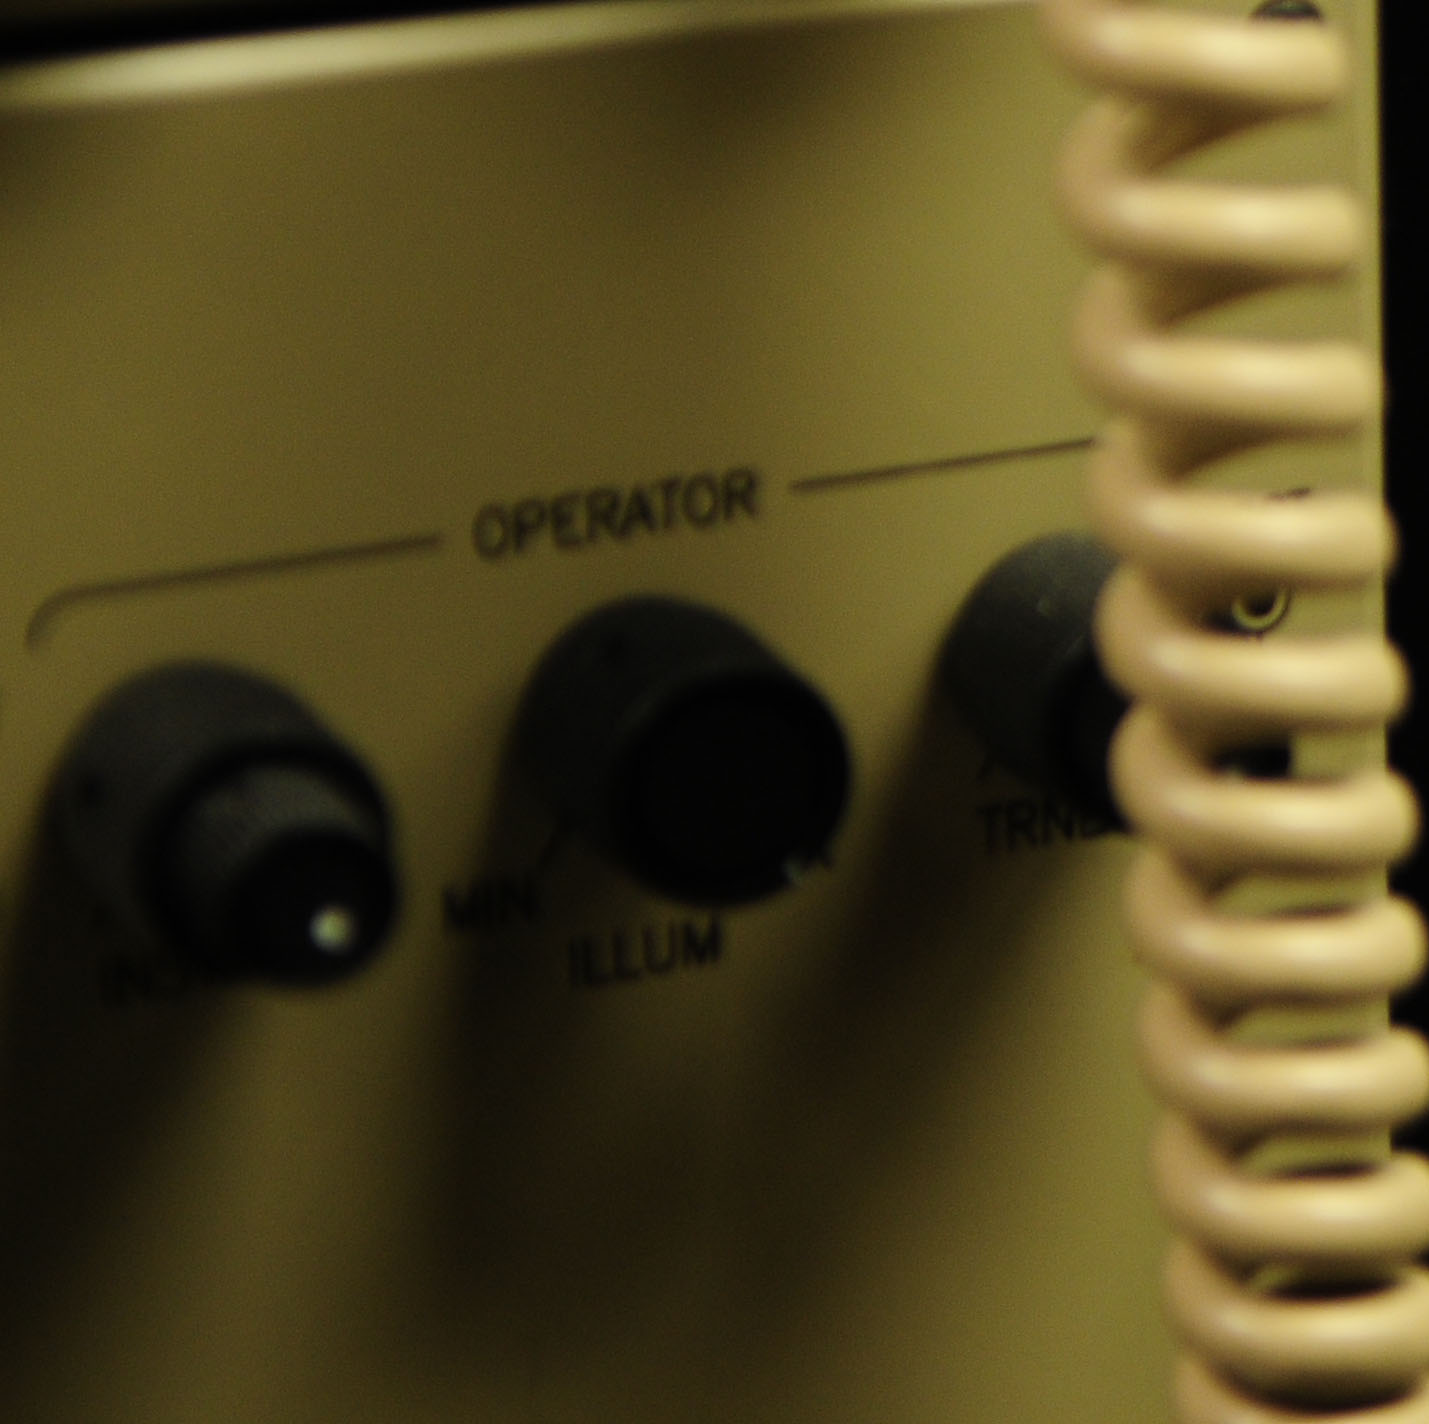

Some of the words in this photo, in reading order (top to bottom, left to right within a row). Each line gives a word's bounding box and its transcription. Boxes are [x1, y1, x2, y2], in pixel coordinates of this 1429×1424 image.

[472, 467, 763, 562] OPERATOR
[445, 875, 540, 932] MIN
[568, 916, 725, 988] ILLUM
